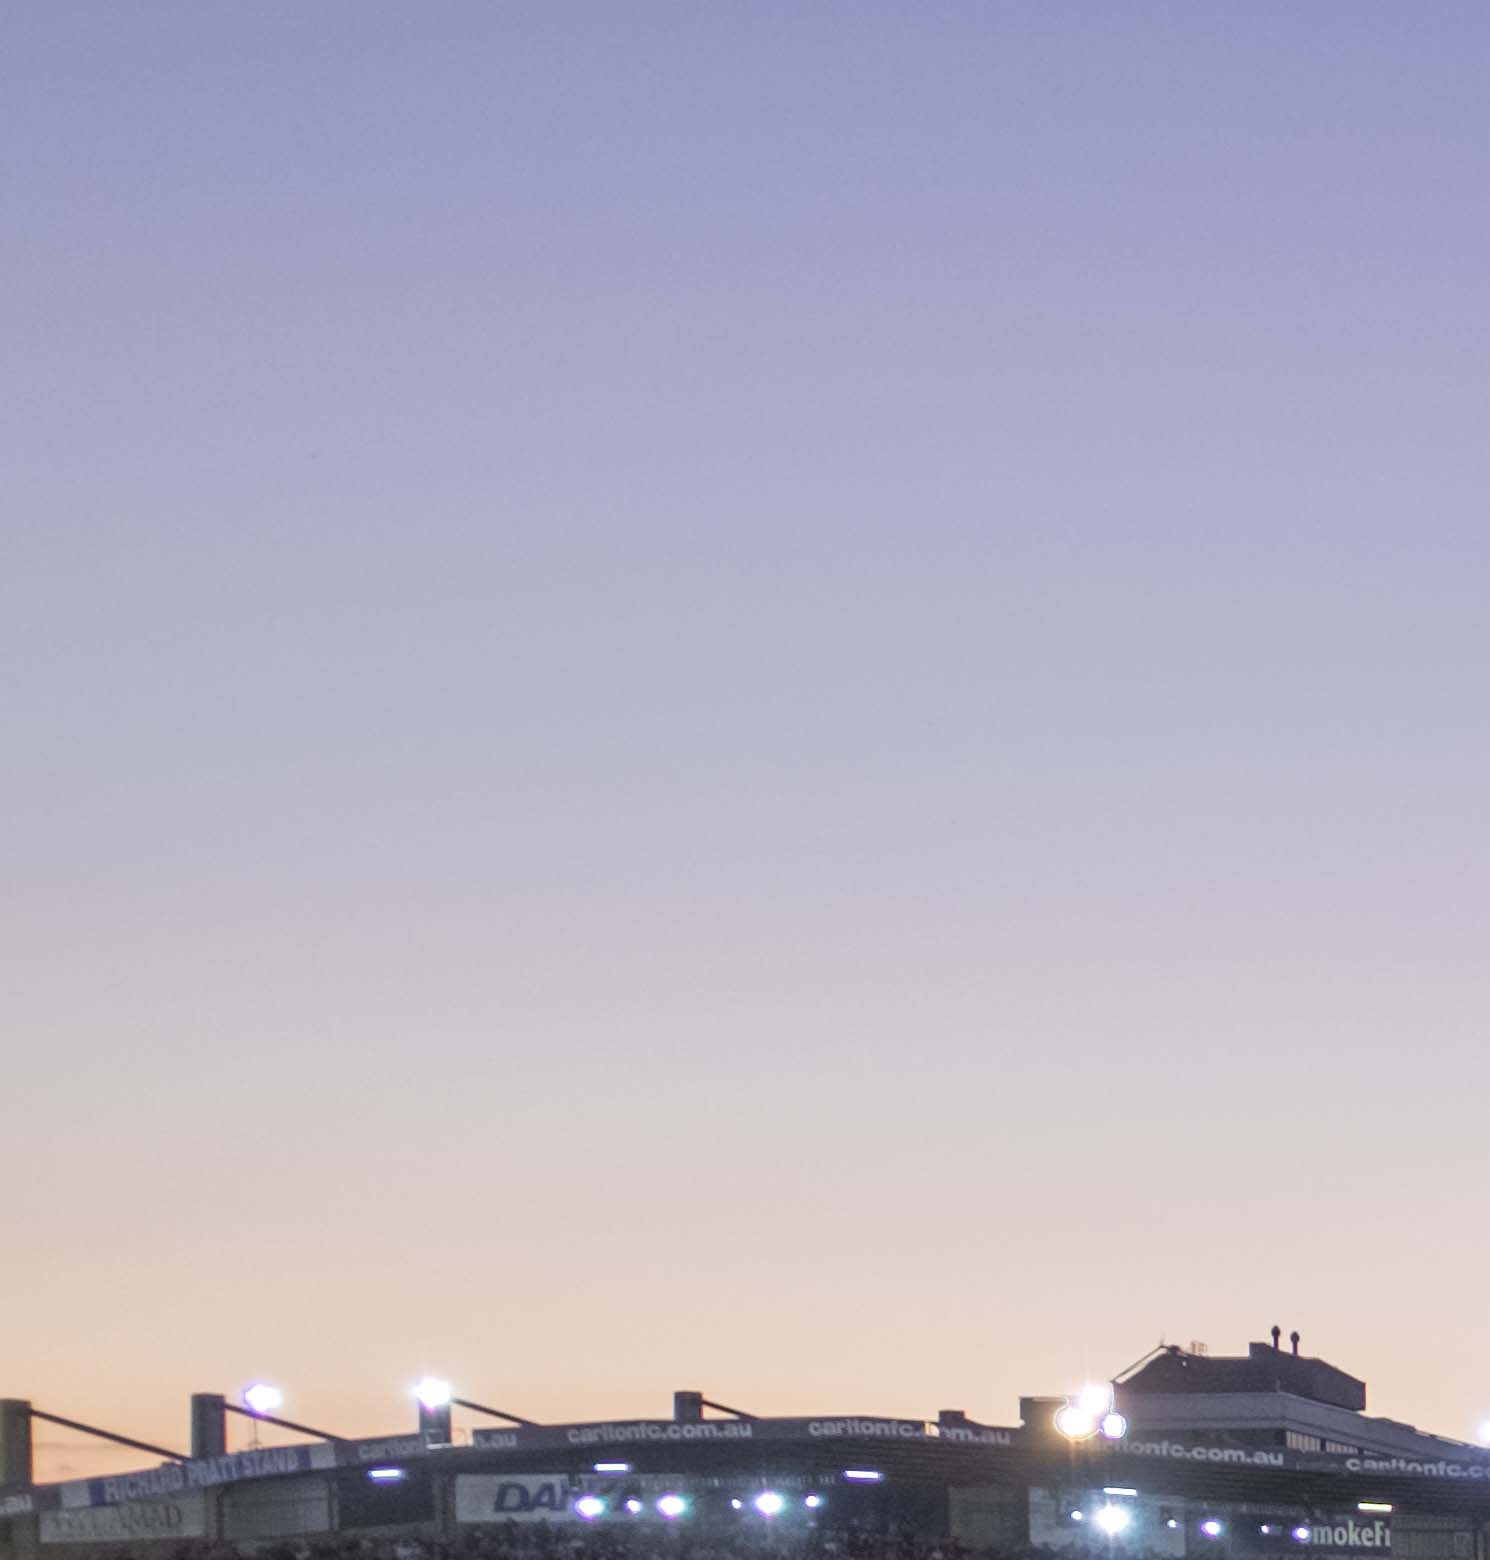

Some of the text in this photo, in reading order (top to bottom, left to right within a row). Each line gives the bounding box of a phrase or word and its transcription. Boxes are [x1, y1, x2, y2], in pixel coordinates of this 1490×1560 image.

[567, 1422, 752, 1445] carltonfc.com.au
[104, 1452, 299, 1500] RICHARD PRATT STAND
